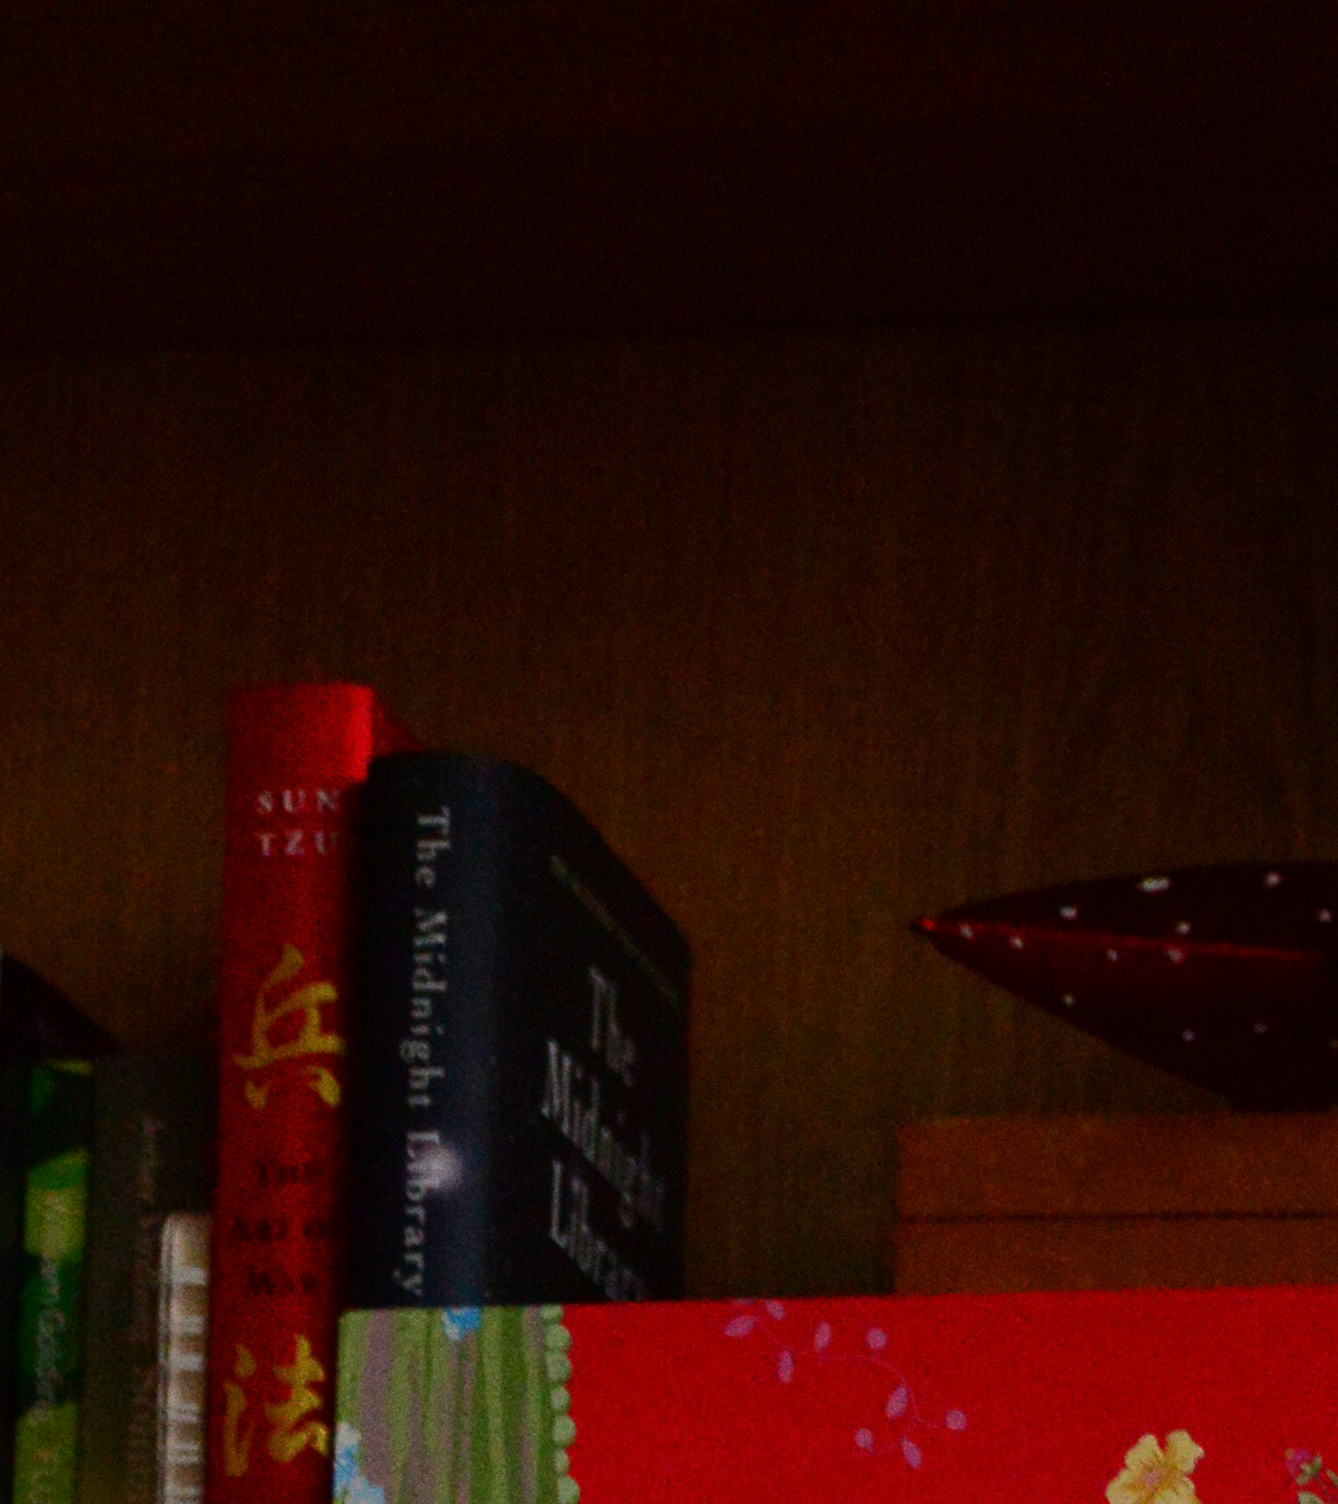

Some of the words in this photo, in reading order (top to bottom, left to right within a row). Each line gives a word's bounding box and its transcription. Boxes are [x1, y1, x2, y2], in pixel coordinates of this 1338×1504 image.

[255, 788, 342, 815] SUN
[257, 829, 340, 858] TZU
[414, 805, 453, 889] The
[398, 906, 449, 1107] Midnight
[392, 1130, 442, 1297] Library
